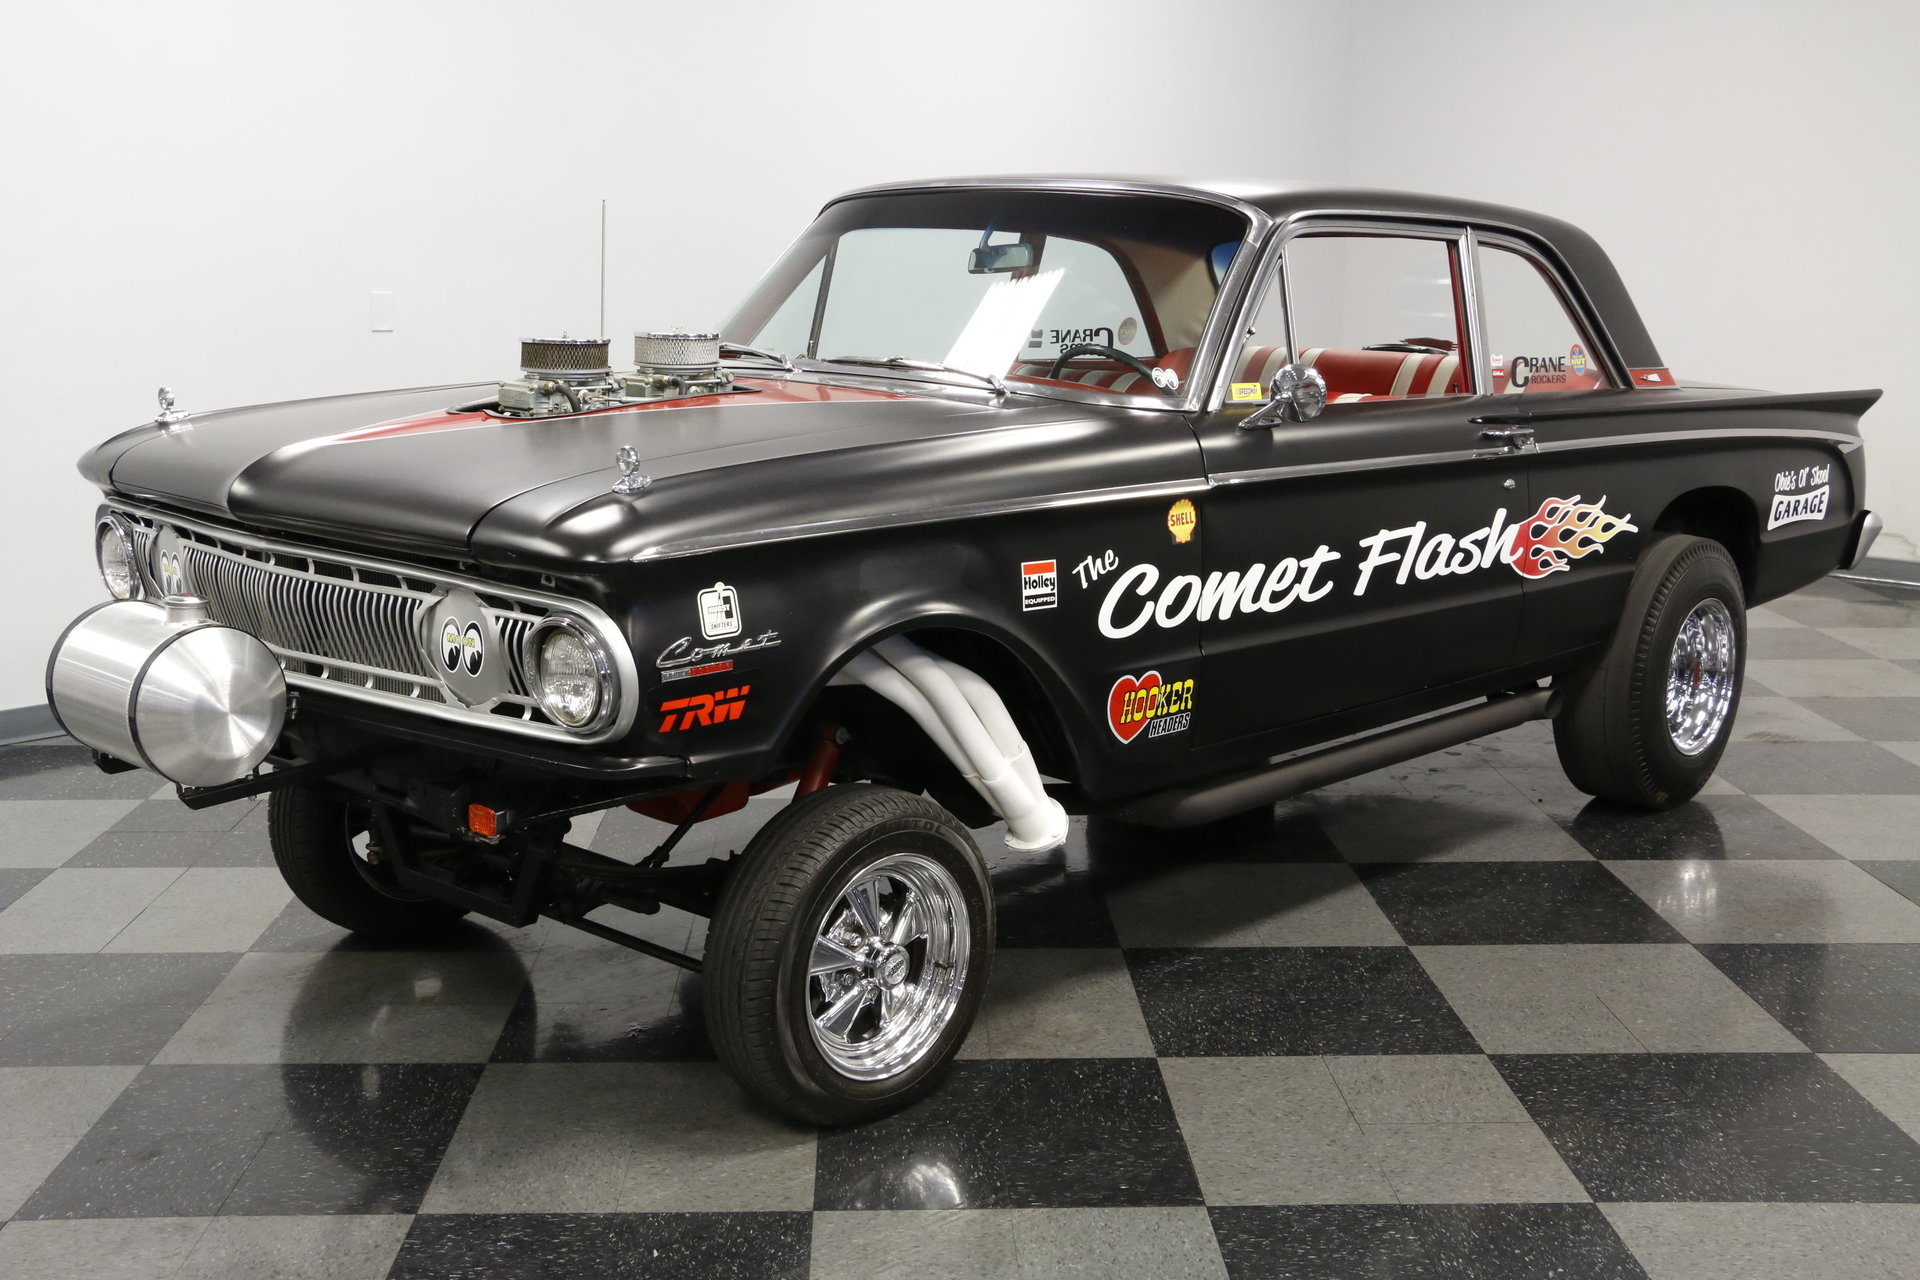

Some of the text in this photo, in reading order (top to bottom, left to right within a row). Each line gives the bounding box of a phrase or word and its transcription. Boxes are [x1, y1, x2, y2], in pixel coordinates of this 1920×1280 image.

[1511, 356, 1566, 388] CRANE
[1531, 375, 1566, 384] ROCKERS
[1170, 512, 1194, 526] SHELL
[1774, 491, 1826, 521] GARAGE
[1024, 575, 1055, 591] Holley
[1072, 508, 1523, 639] The Comet Flash
[1025, 596, 1055, 605] EQUIPPED
[447, 633, 476, 648] MOON
[656, 630, 782, 668] Comet
[659, 685, 750, 733] TRW
[1120, 679, 1194, 724] HOOKER
[1149, 712, 1191, 738] HEADERS
